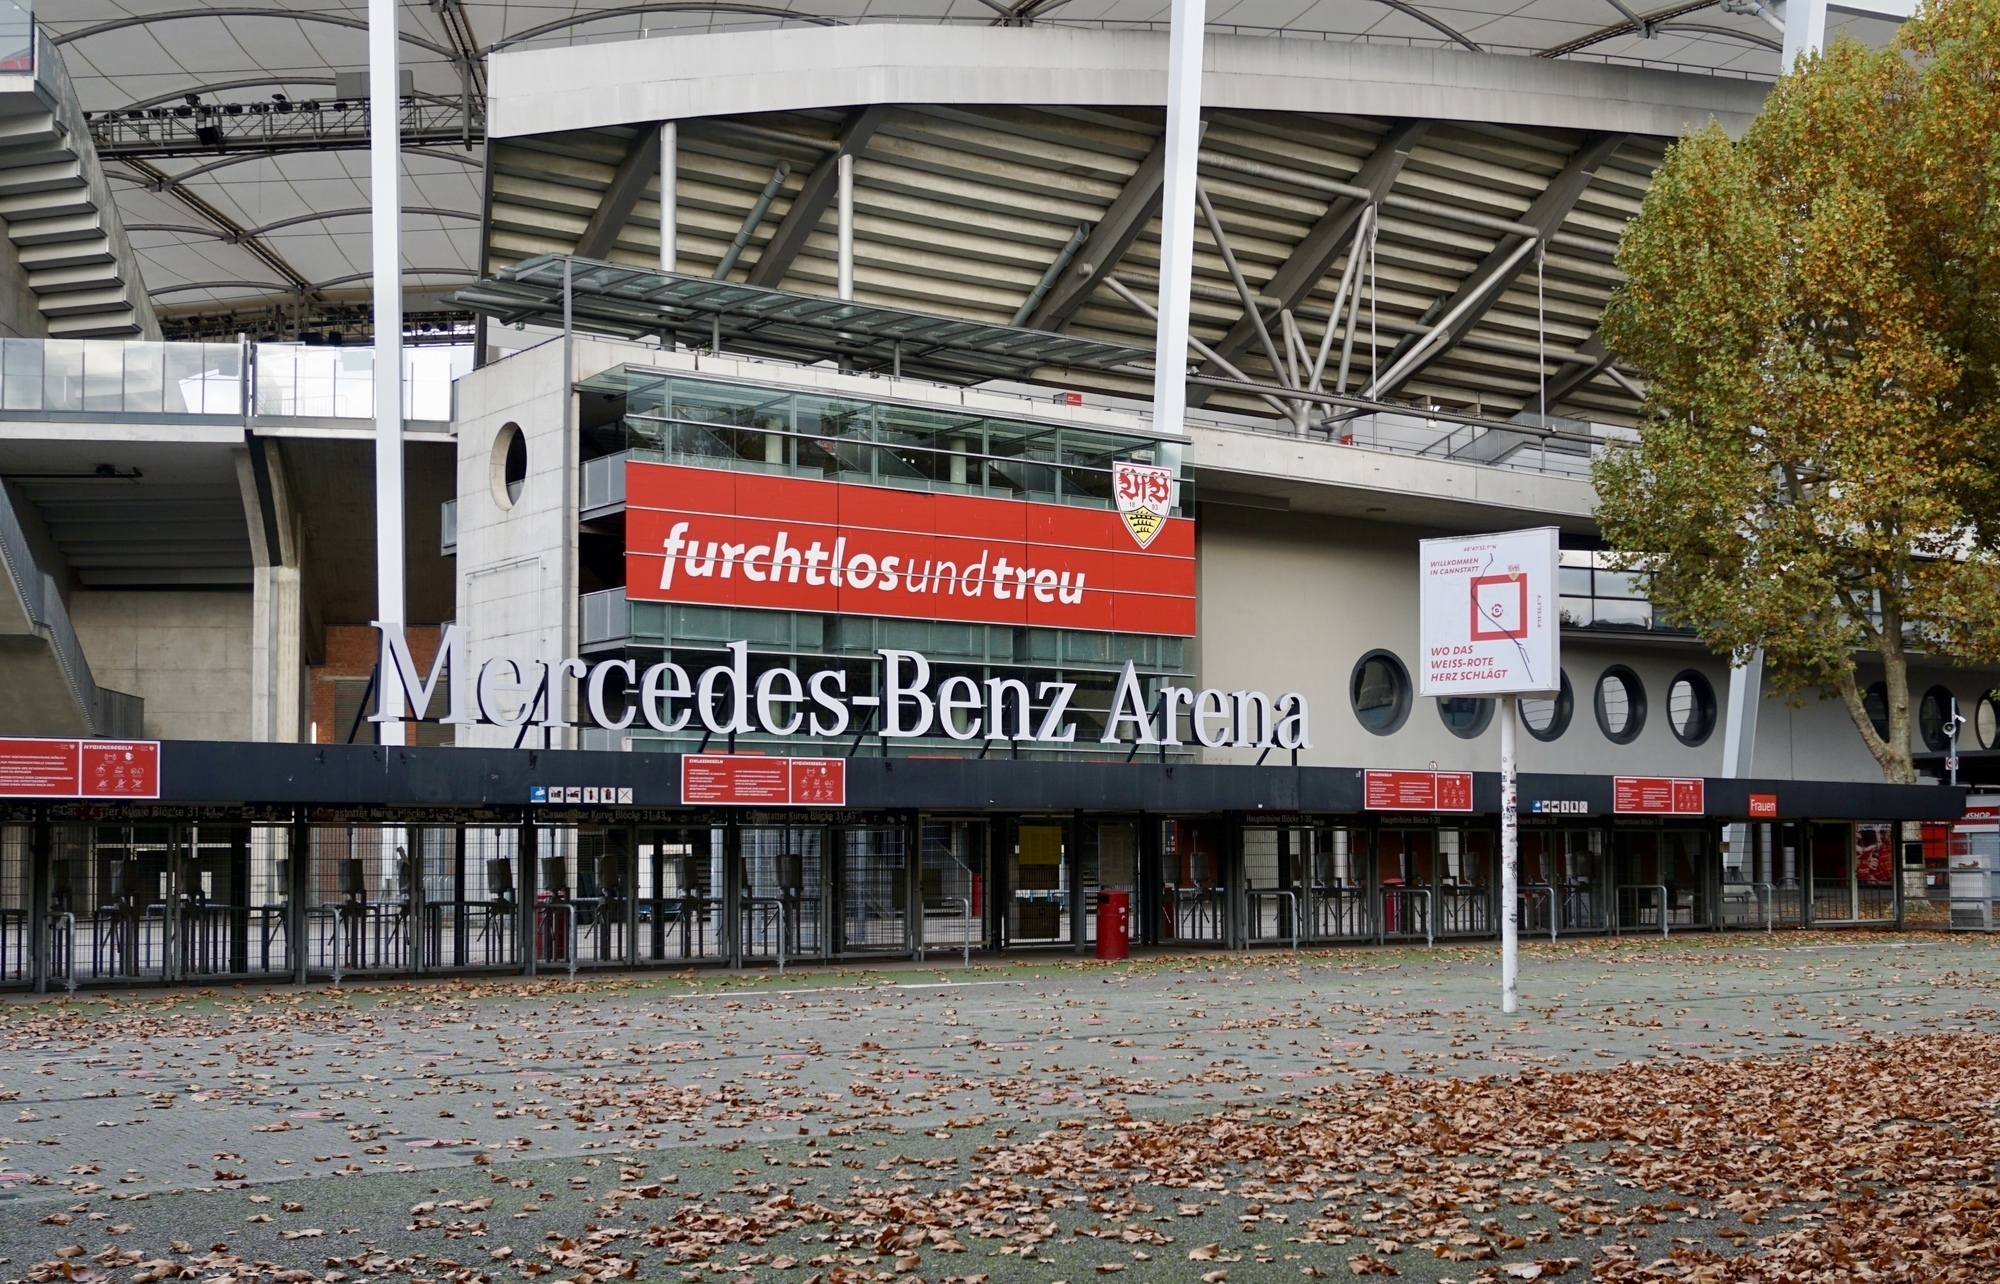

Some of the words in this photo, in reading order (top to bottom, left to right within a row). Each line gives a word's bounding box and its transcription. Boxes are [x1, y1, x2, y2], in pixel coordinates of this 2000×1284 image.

[1430, 557, 1479, 568] WILLKOMMEN
[1439, 566, 1480, 575] CANNSTATT
[1431, 647, 1450, 656] WO
[1452, 645, 1473, 655] DAS
[1431, 657, 1494, 669] WEISS-ROTE
[1431, 671, 1458, 682] HERZ
[1460, 667, 1508, 681] SCHLÄGT
[366, 619, 1077, 743] Mercedes-Benz
[1100, 658, 1314, 751] Arena
[1750, 799, 1776, 812] Frauen
